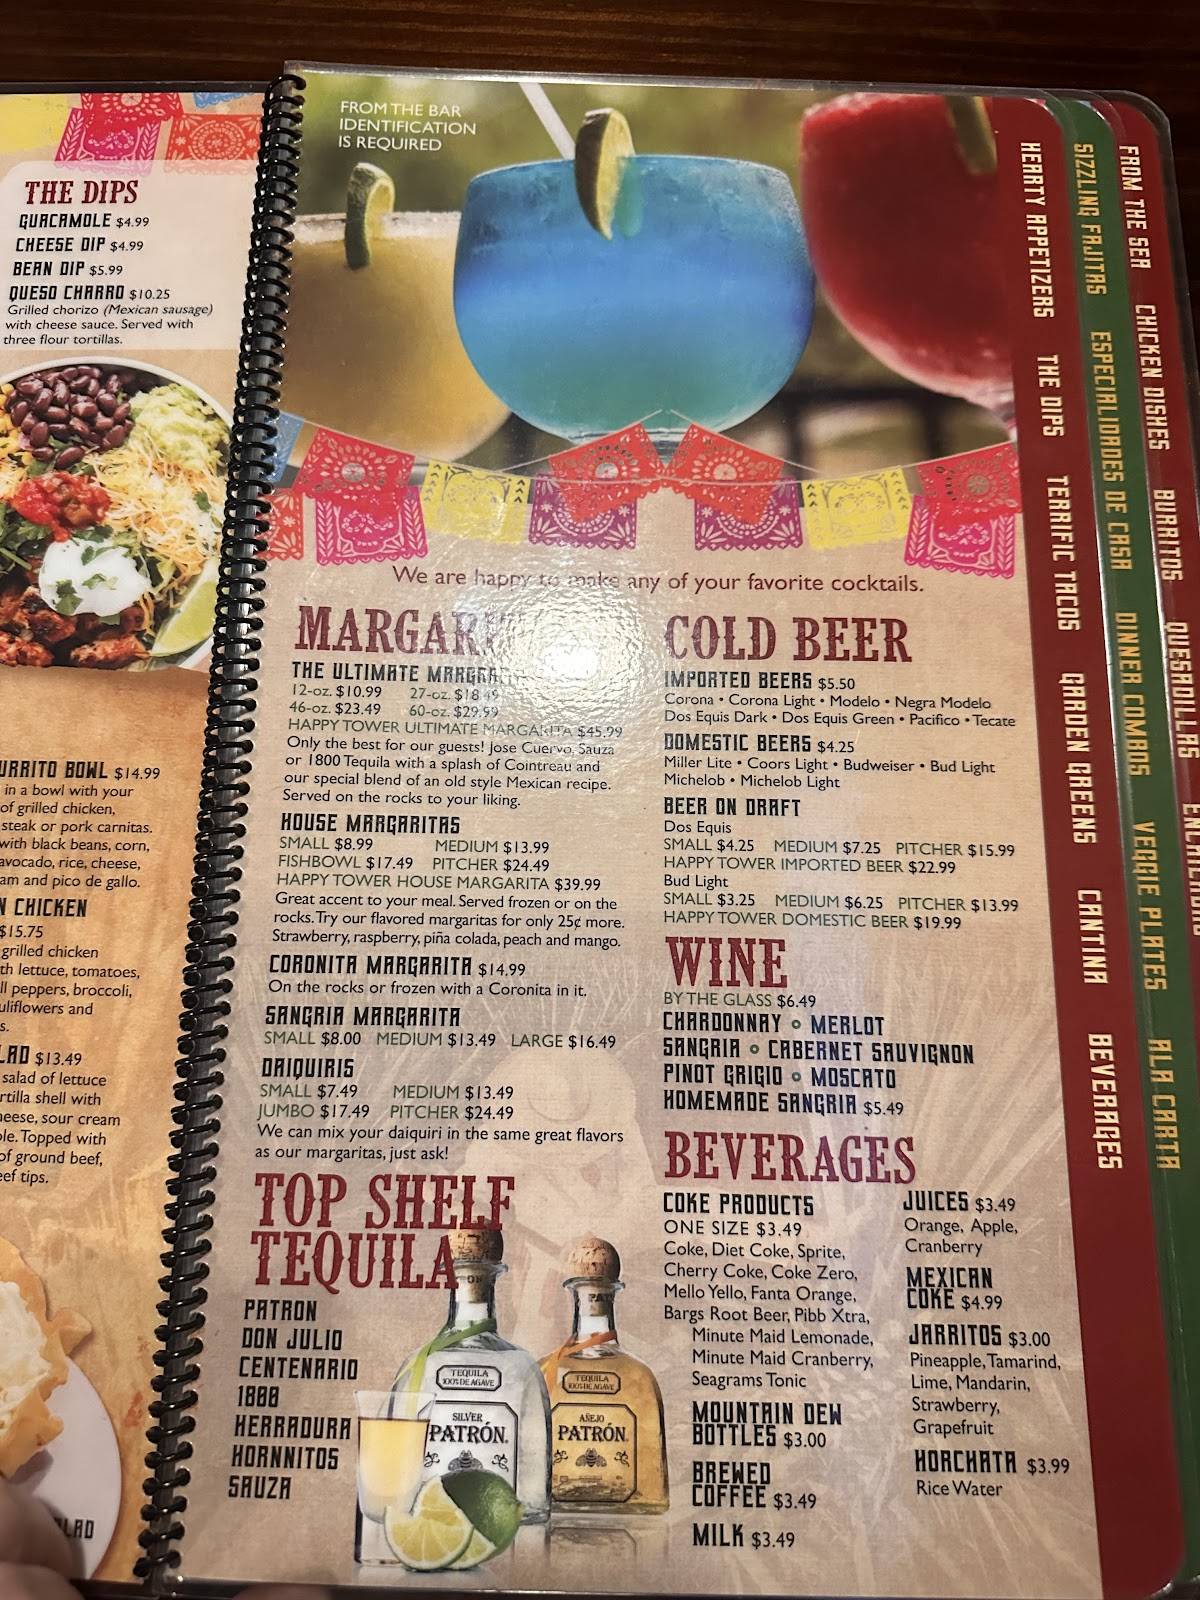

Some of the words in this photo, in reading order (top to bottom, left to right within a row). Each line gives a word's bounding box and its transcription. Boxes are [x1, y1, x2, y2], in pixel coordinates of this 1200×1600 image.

[341, 101, 386, 114] FROM
[391, 104, 422, 115] THE
[430, 105, 460, 117] BAR
[340, 119, 475, 134] IDENTIFICATION
[339, 136, 350, 147] IS
[357, 136, 441, 151] REQUIRED
[1020, 142, 1047, 207] HEARTY
[1119, 144, 1143, 191] FROM
[1074, 143, 1100, 217] SIZZLING
[26, 181, 73, 204] THE
[82, 181, 138, 203] DIPS
[20, 214, 111, 229] GUACAMOLE
[117, 218, 148, 228] $4.99
[1124, 198, 1148, 232] THE
[17, 238, 73, 251] CHEESE
[81, 238, 105, 251] DIP
[111, 242, 143, 252] $4.99
[1128, 236, 1152, 269] SEA
[14, 262, 52, 275] BEAN
[60, 262, 84, 275] DIP
[90, 266, 122, 276] $5.99
[1026, 214, 1055, 319] APPETIZERS
[1080, 224, 1107, 296] FAJITAS
[10, 286, 56, 301] QUESO
[64, 286, 124, 299] CHARRO
[130, 290, 169, 300] $10.25
[8, 305, 48, 314] Grilled
[53, 305, 98, 314] chorizo
[104, 305, 158, 316] (Mexican
[163, 305, 212, 316] sausage)
[6, 320, 31, 329] with
[36, 320, 76, 329] cheese
[122, 319, 162, 328] Served
[167, 319, 192, 328] with
[4, 335, 35, 344] three
[41, 334, 69, 344] flour
[74, 335, 122, 343] tortillas.
[1134, 304, 1162, 379] CHICKEN
[1037, 354, 1061, 388] THE
[1040, 396, 1065, 438] DIPS
[1090, 331, 1126, 482] ESPECIALIDADES
[1143, 387, 1170, 451] DISHES
[1104, 490, 1127, 514] DE
[1046, 475, 1075, 562] TERRIFIC
[1107, 522, 1133, 571] CASA
[1153, 489, 1184, 581] BURRITOS
[393, 565, 428, 585] We
[435, 572, 466, 585] are
[474, 569, 531, 588] happy
[627, 577, 660, 593] any
[667, 572, 690, 589] of
[694, 577, 742, 595] your
[748, 572, 824, 592] favorite
[831, 574, 924, 593] cocktails.
[1053, 570, 1081, 632] TACOS
[664, 615, 775, 660] COLD
[793, 618, 912, 662] BEER
[1114, 612, 1143, 684] DINNER
[665, 671, 749, 687] IMPORTED
[759, 673, 811, 688] BEERS
[819, 678, 854, 690] $5.50
[1058, 672, 1090, 753] GARDEN
[665, 734, 748, 750] DOMESTIC
[758, 735, 810, 751] BEERS
[818, 741, 853, 753] $4.25
[1121, 694, 1151, 777] COMBOS
[65, 762, 107, 778] BOWL
[115, 768, 159, 780] $14.99
[1065, 761, 1097, 845] GREENS
[281, 813, 337, 831] HOUSE
[347, 815, 459, 835] MARGARITAS
[280, 837, 329, 849] SMALL
[335, 838, 372, 851] $8.99
[436, 840, 497, 852] MEDIUM
[504, 842, 548, 854] $13.99
[1130, 821, 1161, 896] VEGGIE
[15, 899, 86, 916] CHICKEN
[1077, 889, 1109, 984] CANTINA
[1137, 905, 1168, 991] PLATES
[1, 945, 43, 959] grilled
[48, 945, 98, 958] chicken
[666, 937, 787, 988] WINE
[270, 955, 356, 973] CORONITA
[367, 956, 471, 977] MARGARITA
[479, 964, 525, 977] $14.99
[665, 992, 683, 1004] BY
[687, 993, 717, 1005] THE
[724, 994, 771, 1006] GLASS
[778, 995, 815, 1008] $6.49
[266, 1006, 343, 1027] SANGRIA
[354, 1007, 460, 1028] MARGARITA
[664, 1012, 781, 1032] CHARDONNAY
[811, 1016, 884, 1035] MERLOT
[664, 1038, 739, 1059] SANGRIA
[769, 1040, 862, 1061] CABERNET
[872, 1043, 973, 1065] SAUVIGNON
[262, 1058, 353, 1080] DAIQUIRIS
[1088, 1033, 1123, 1170] BEVERAGES
[1152, 1094, 1181, 1170] CARTA
[665, 1131, 915, 1184] BEVERAGES
[255, 1173, 346, 1227] TOP
[365, 1175, 515, 1230] SHELF
[664, 1193, 709, 1213] COKE
[720, 1194, 813, 1215] PRODUCTS
[904, 1191, 968, 1211] JUICES
[976, 1198, 1015, 1213] $3.49
[905, 1218, 963, 1236] Orange,
[971, 1219, 1017, 1236] Apple,
[250, 1230, 459, 1295] TEQUILA
[906, 1267, 993, 1289] MEXICAN
[245, 1300, 316, 1321] PATRON
[907, 1289, 955, 1310] COKE
[962, 1296, 1002, 1311] $4.99
[242, 1328, 277, 1348] DON
[287, 1329, 342, 1350] JULIO
[910, 1324, 1001, 1345] JARRITOS
[1009, 1332, 1050, 1348] $3.00
[240, 1357, 357, 1379] CENTENARIO
[451, 1369, 489, 1377] TEQUILA
[239, 1386, 279, 1407] 1800
[452, 1412, 483, 1422] SILVER
[693, 1401, 793, 1424] MOUNTAIN
[805, 1403, 841, 1424] DEW
[235, 1415, 351, 1439] HERRADURA
[692, 1424, 774, 1446] BOTTLES
[784, 1433, 825, 1449] $3.00
[232, 1445, 338, 1469] HORNNITOS
[915, 1450, 1016, 1473] HORCHATA
[1028, 1459, 1069, 1475] $3.99
[692, 1462, 771, 1484] BREWED
[229, 1476, 291, 1499] SAUZA
[692, 1485, 766, 1508] COFFEE
[774, 1493, 816, 1510] $3.49
[918, 1480, 949, 1495] Rice
[953, 1481, 1002, 1496] Water
[693, 1524, 743, 1546] MILK
[752, 1532, 794, 1549] $3.49
